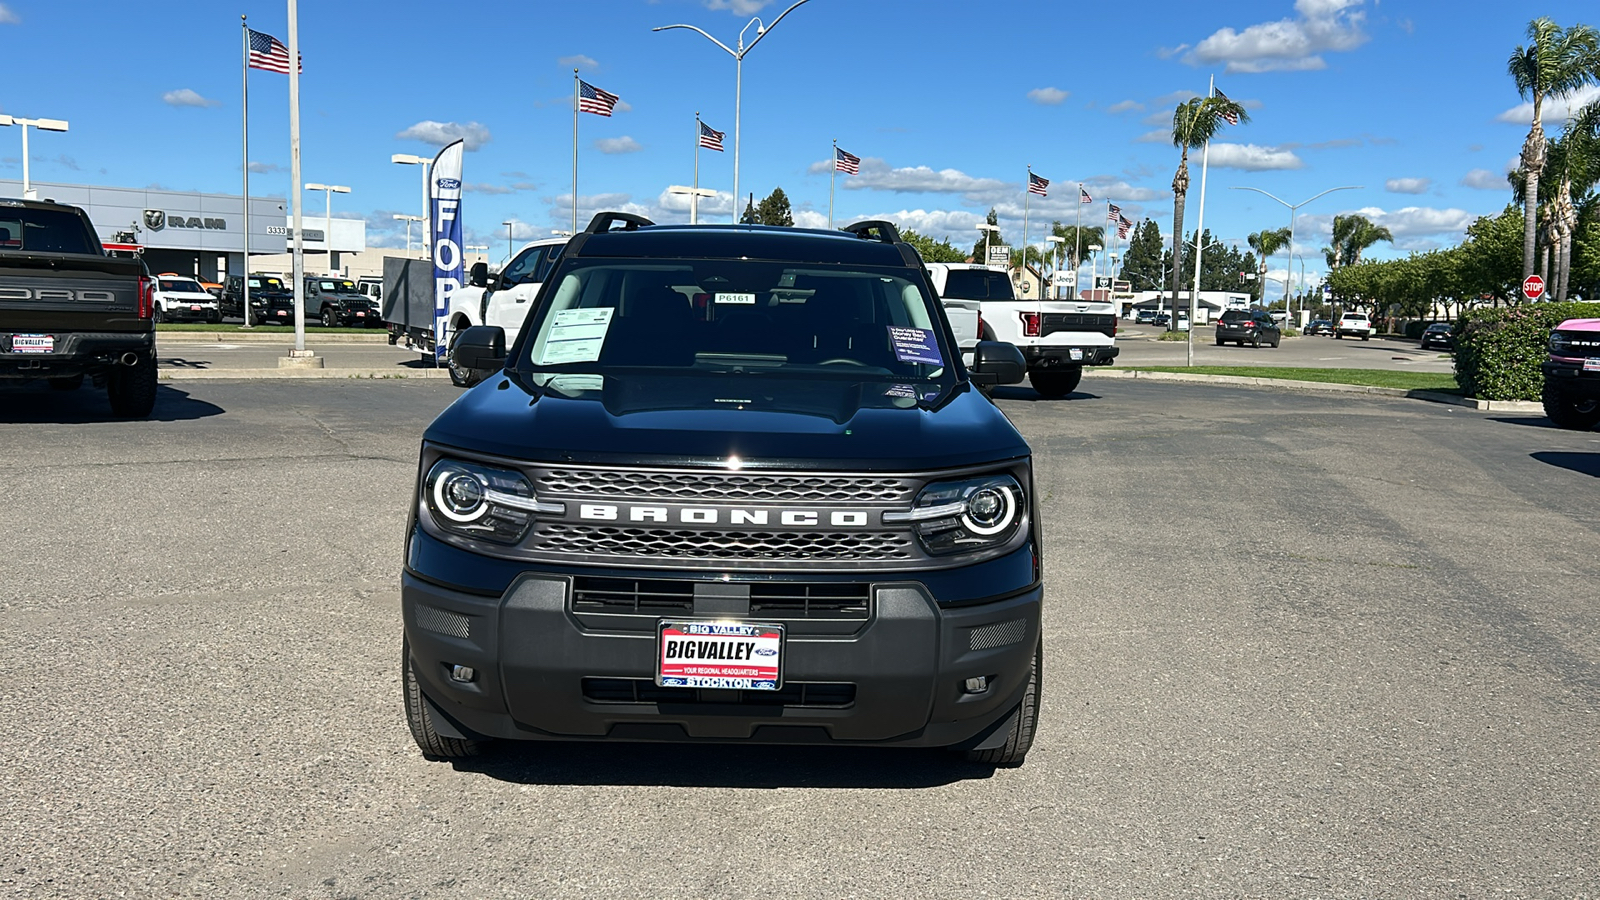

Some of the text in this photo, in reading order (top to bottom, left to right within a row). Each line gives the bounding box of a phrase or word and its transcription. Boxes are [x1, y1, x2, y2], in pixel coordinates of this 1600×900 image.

[439, 179, 460, 189] Ford
[167, 216, 226, 230] RAM
[267, 226, 286, 235] 3333
[1056, 275, 1074, 284] Jeep
[1525, 282, 1543, 292] STOP
[719, 294, 749, 302] P6161
[580, 504, 868, 526] BRONCO
[689, 625, 754, 636] BIG VALLEY
[666, 640, 775, 661] BIGVALLEY Ford
[683, 667, 759, 676] YOUR REGIONAL HEADQUARTERS
[686, 677, 752, 689] STOCKTON
